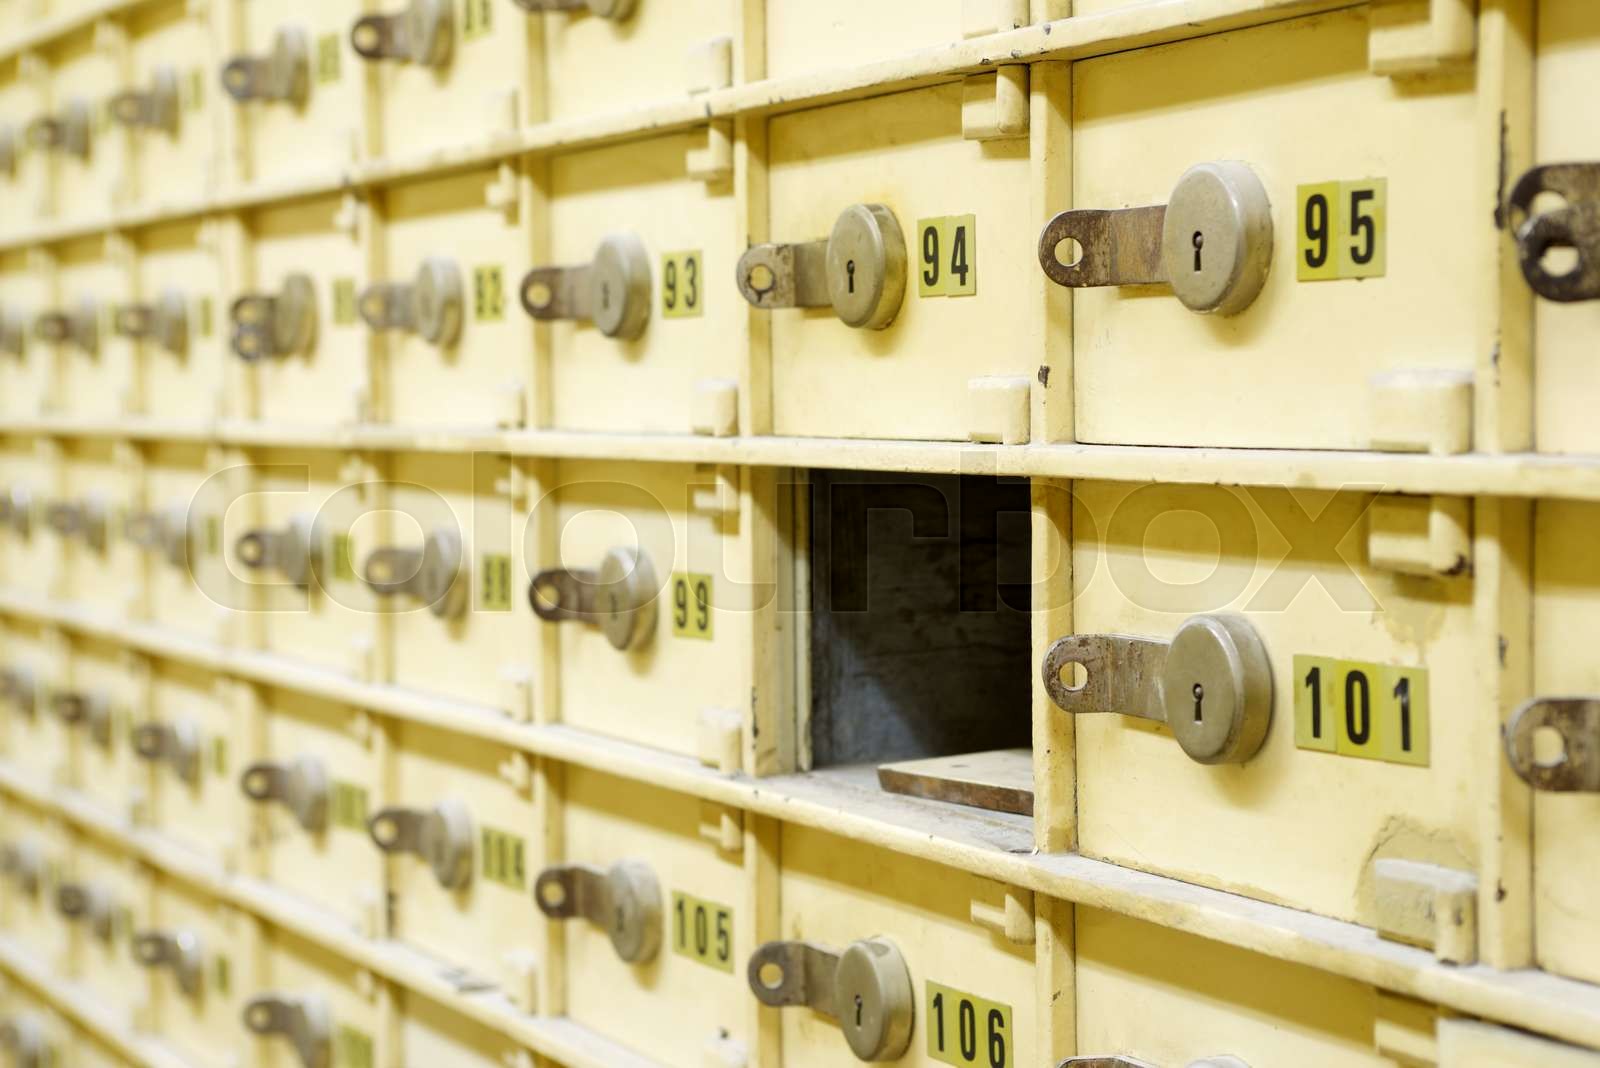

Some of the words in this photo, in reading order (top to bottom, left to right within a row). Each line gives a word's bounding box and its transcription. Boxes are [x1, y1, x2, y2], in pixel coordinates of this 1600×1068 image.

[923, 225, 969, 287] 94
[1305, 189, 1375, 268] 95
[665, 256, 698, 309] 93
[674, 579, 709, 632] 99
[1305, 666, 1412, 752] 101
[676, 898, 730, 962] 105
[933, 992, 1006, 1068] 106
